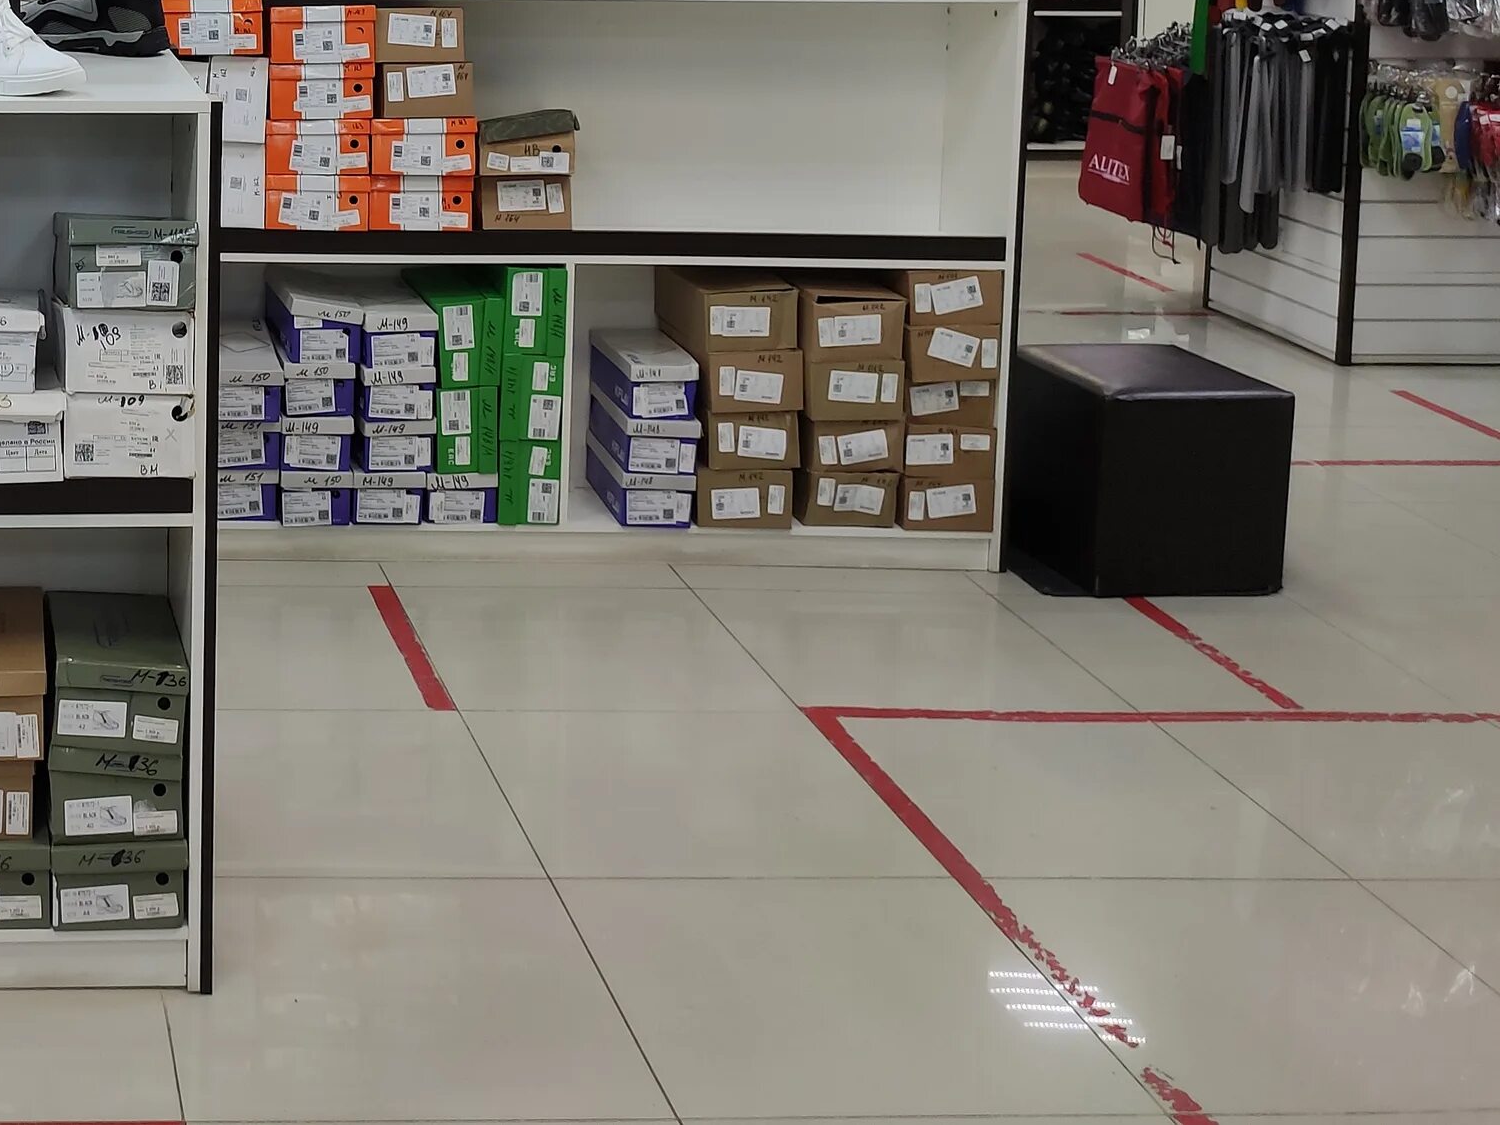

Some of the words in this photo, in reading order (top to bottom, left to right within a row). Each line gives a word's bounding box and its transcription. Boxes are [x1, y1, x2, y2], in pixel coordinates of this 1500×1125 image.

[335, 311, 351, 319] 150
[313, 367, 328, 376] 150
[250, 373, 270, 382] 150
[244, 473, 264, 482] 151
[324, 475, 341, 485] 150
